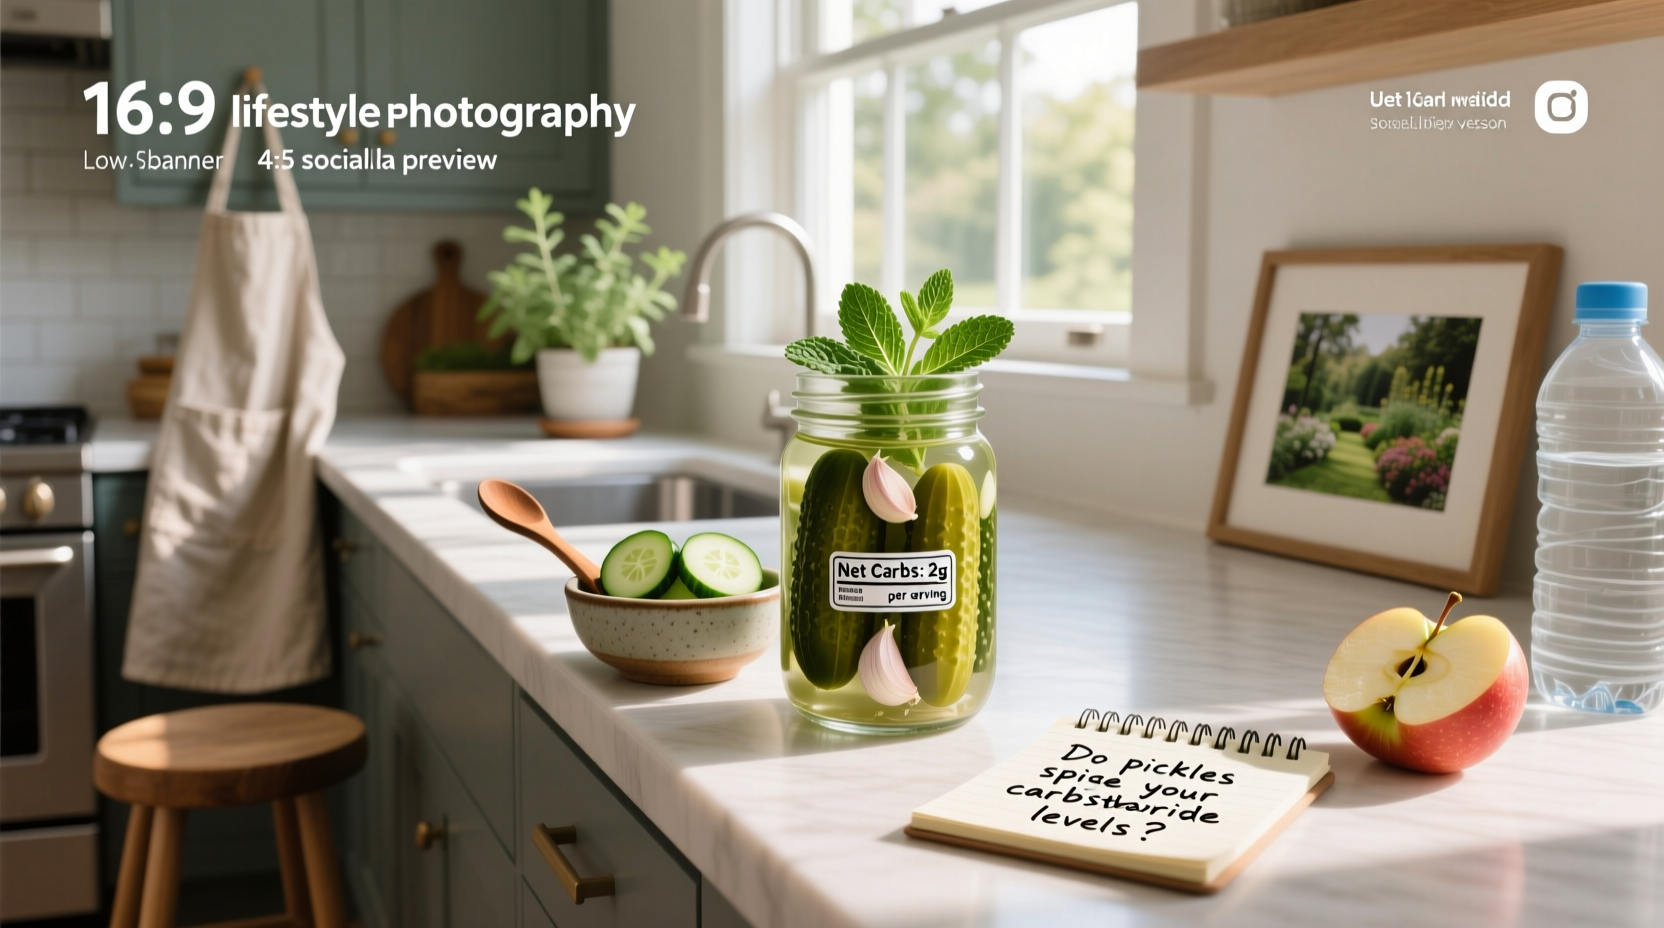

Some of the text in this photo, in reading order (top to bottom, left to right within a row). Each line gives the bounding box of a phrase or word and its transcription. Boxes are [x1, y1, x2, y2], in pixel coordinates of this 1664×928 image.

[838, 561, 948, 581] Net Carbs: 2g
[888, 592, 907, 604] per
[1060, 743, 1235, 785] Do pickles
[1138, 782, 1219, 802] your
